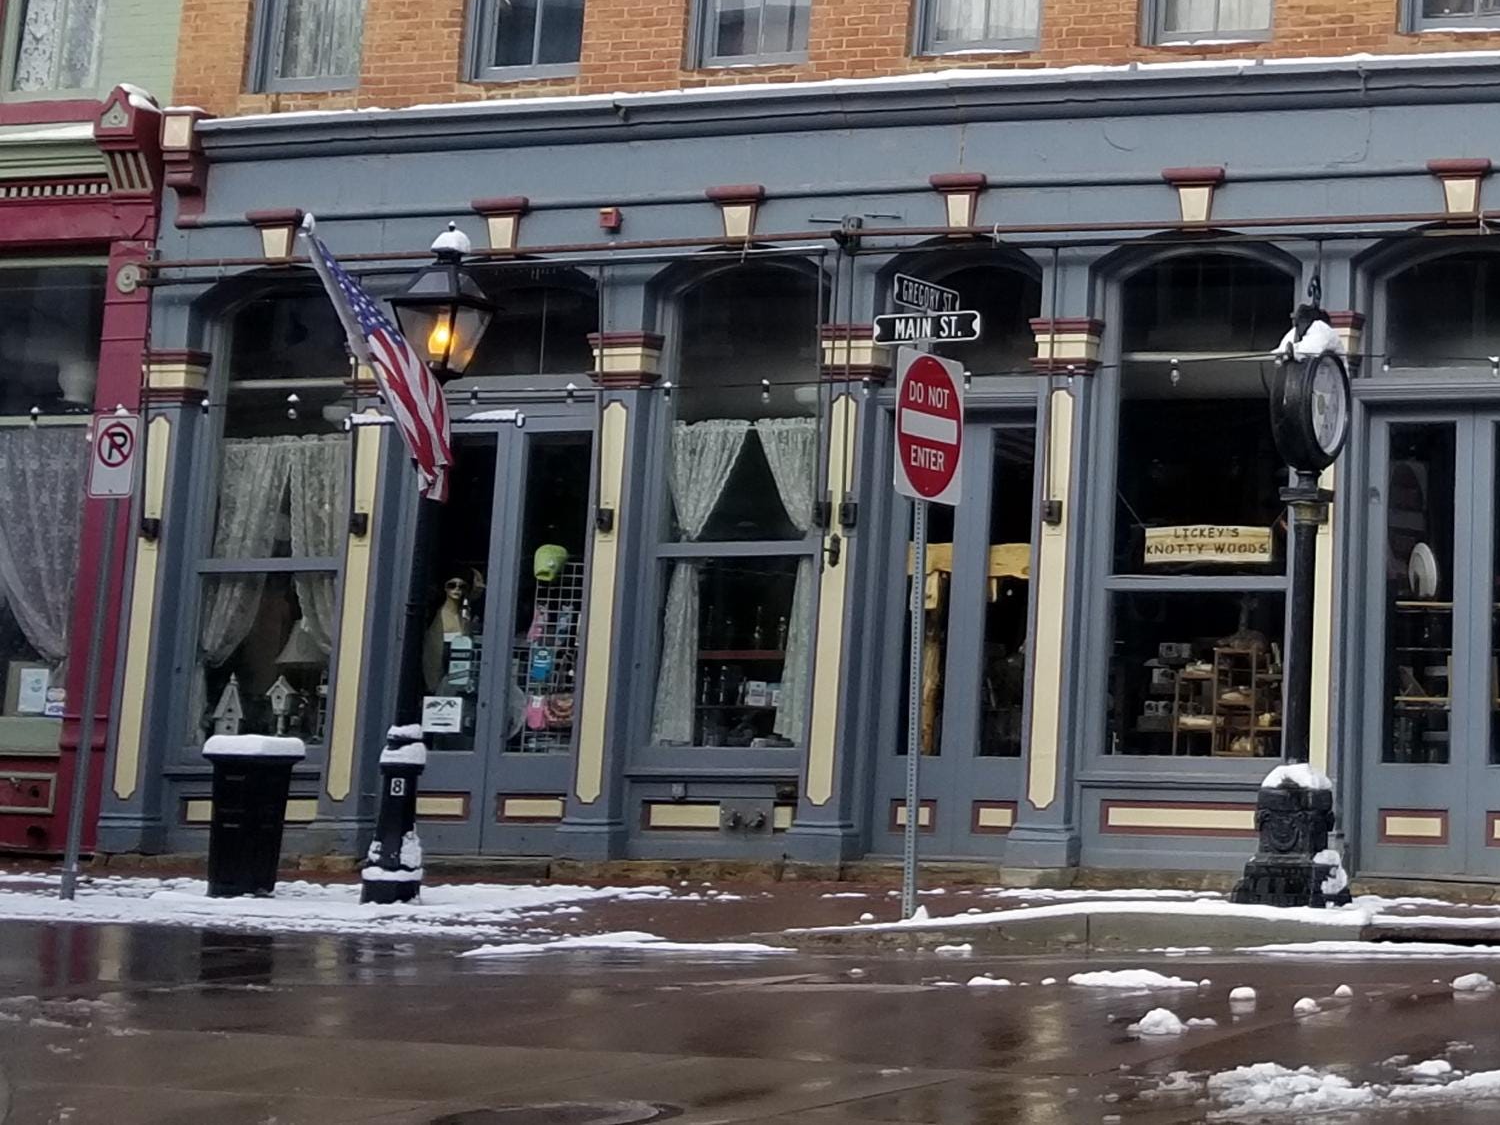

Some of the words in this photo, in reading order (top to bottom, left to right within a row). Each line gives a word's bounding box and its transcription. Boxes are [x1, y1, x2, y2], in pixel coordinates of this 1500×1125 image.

[902, 279, 940, 310] GREGORY
[895, 318, 931, 339] MAIN
[940, 316, 961, 337] ST.
[909, 380, 923, 403] DO
[928, 386, 950, 409] NOT
[911, 445, 945, 472] ENTER
[1173, 528, 1240, 539] LICKEY'S
[1146, 543, 1205, 554] KNOTTY
[1214, 543, 1267, 554] WOODS
[392, 779, 402, 794] 8
